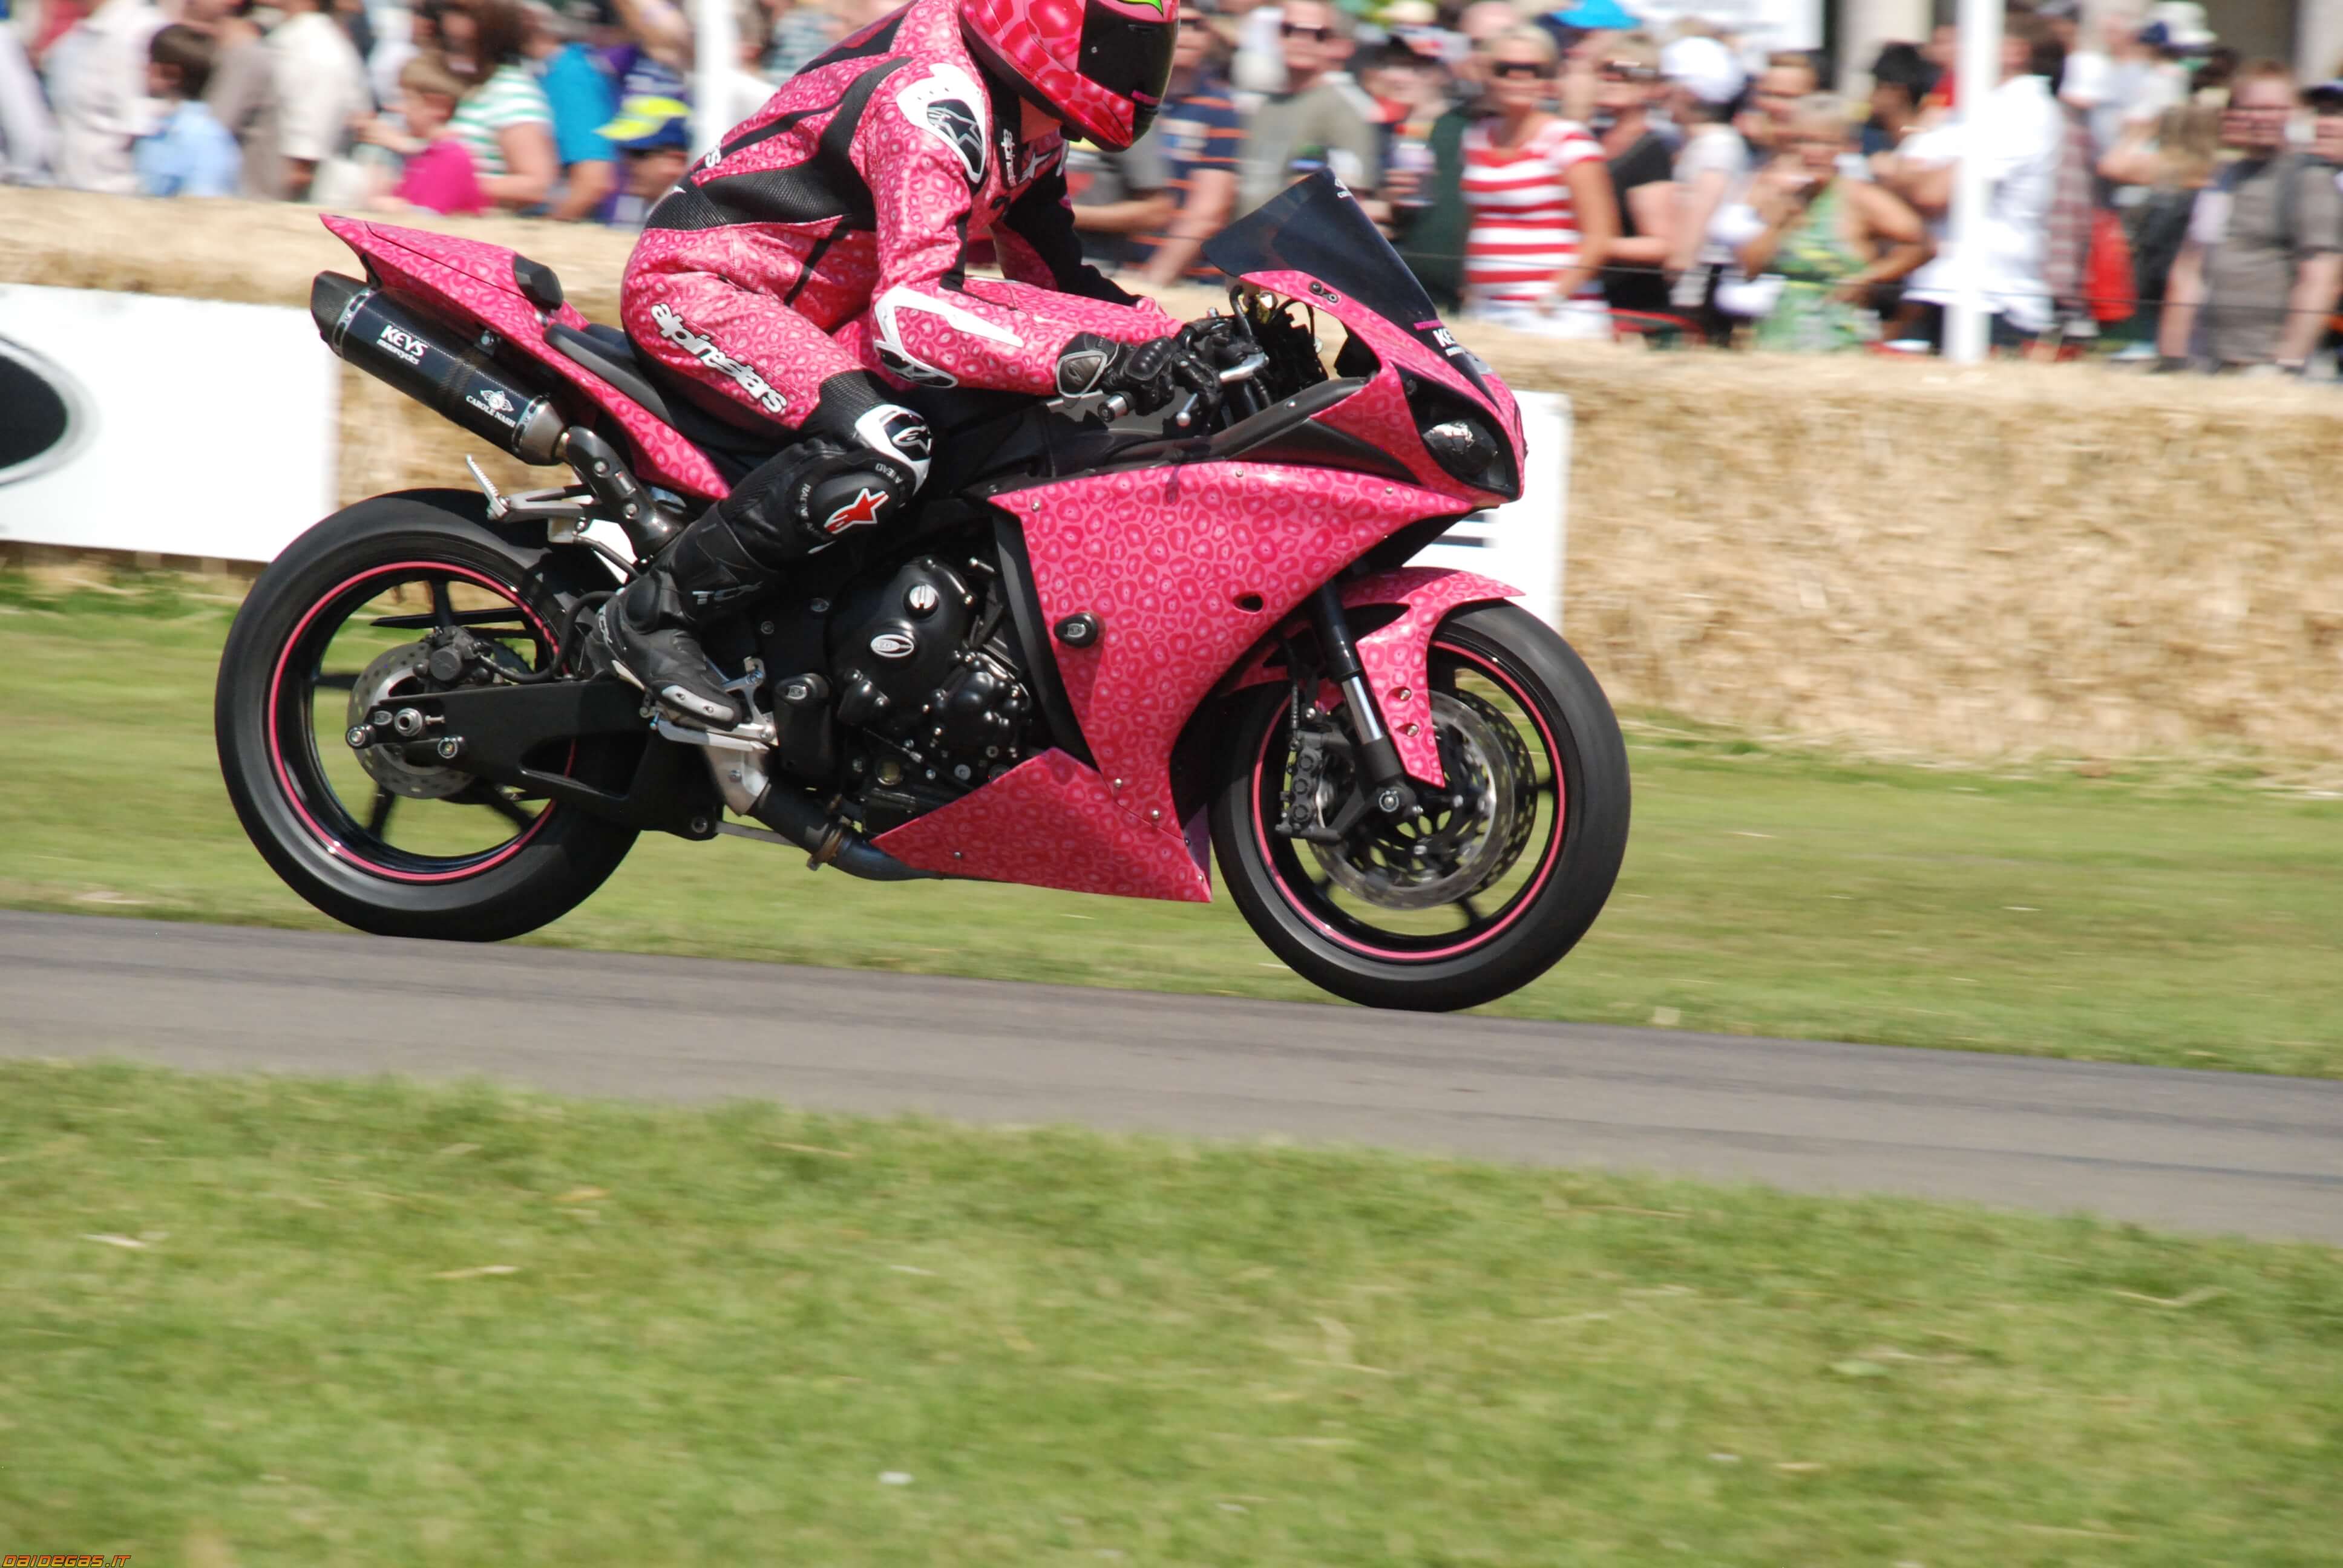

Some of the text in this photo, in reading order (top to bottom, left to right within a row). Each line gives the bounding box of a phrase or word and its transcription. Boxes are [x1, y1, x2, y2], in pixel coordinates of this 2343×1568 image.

[379, 325, 428, 358] KEYS
[1432, 327, 1457, 347] KE
[650, 303, 787, 413] alpinestars
[465, 395, 516, 428] CAROLE NASH
